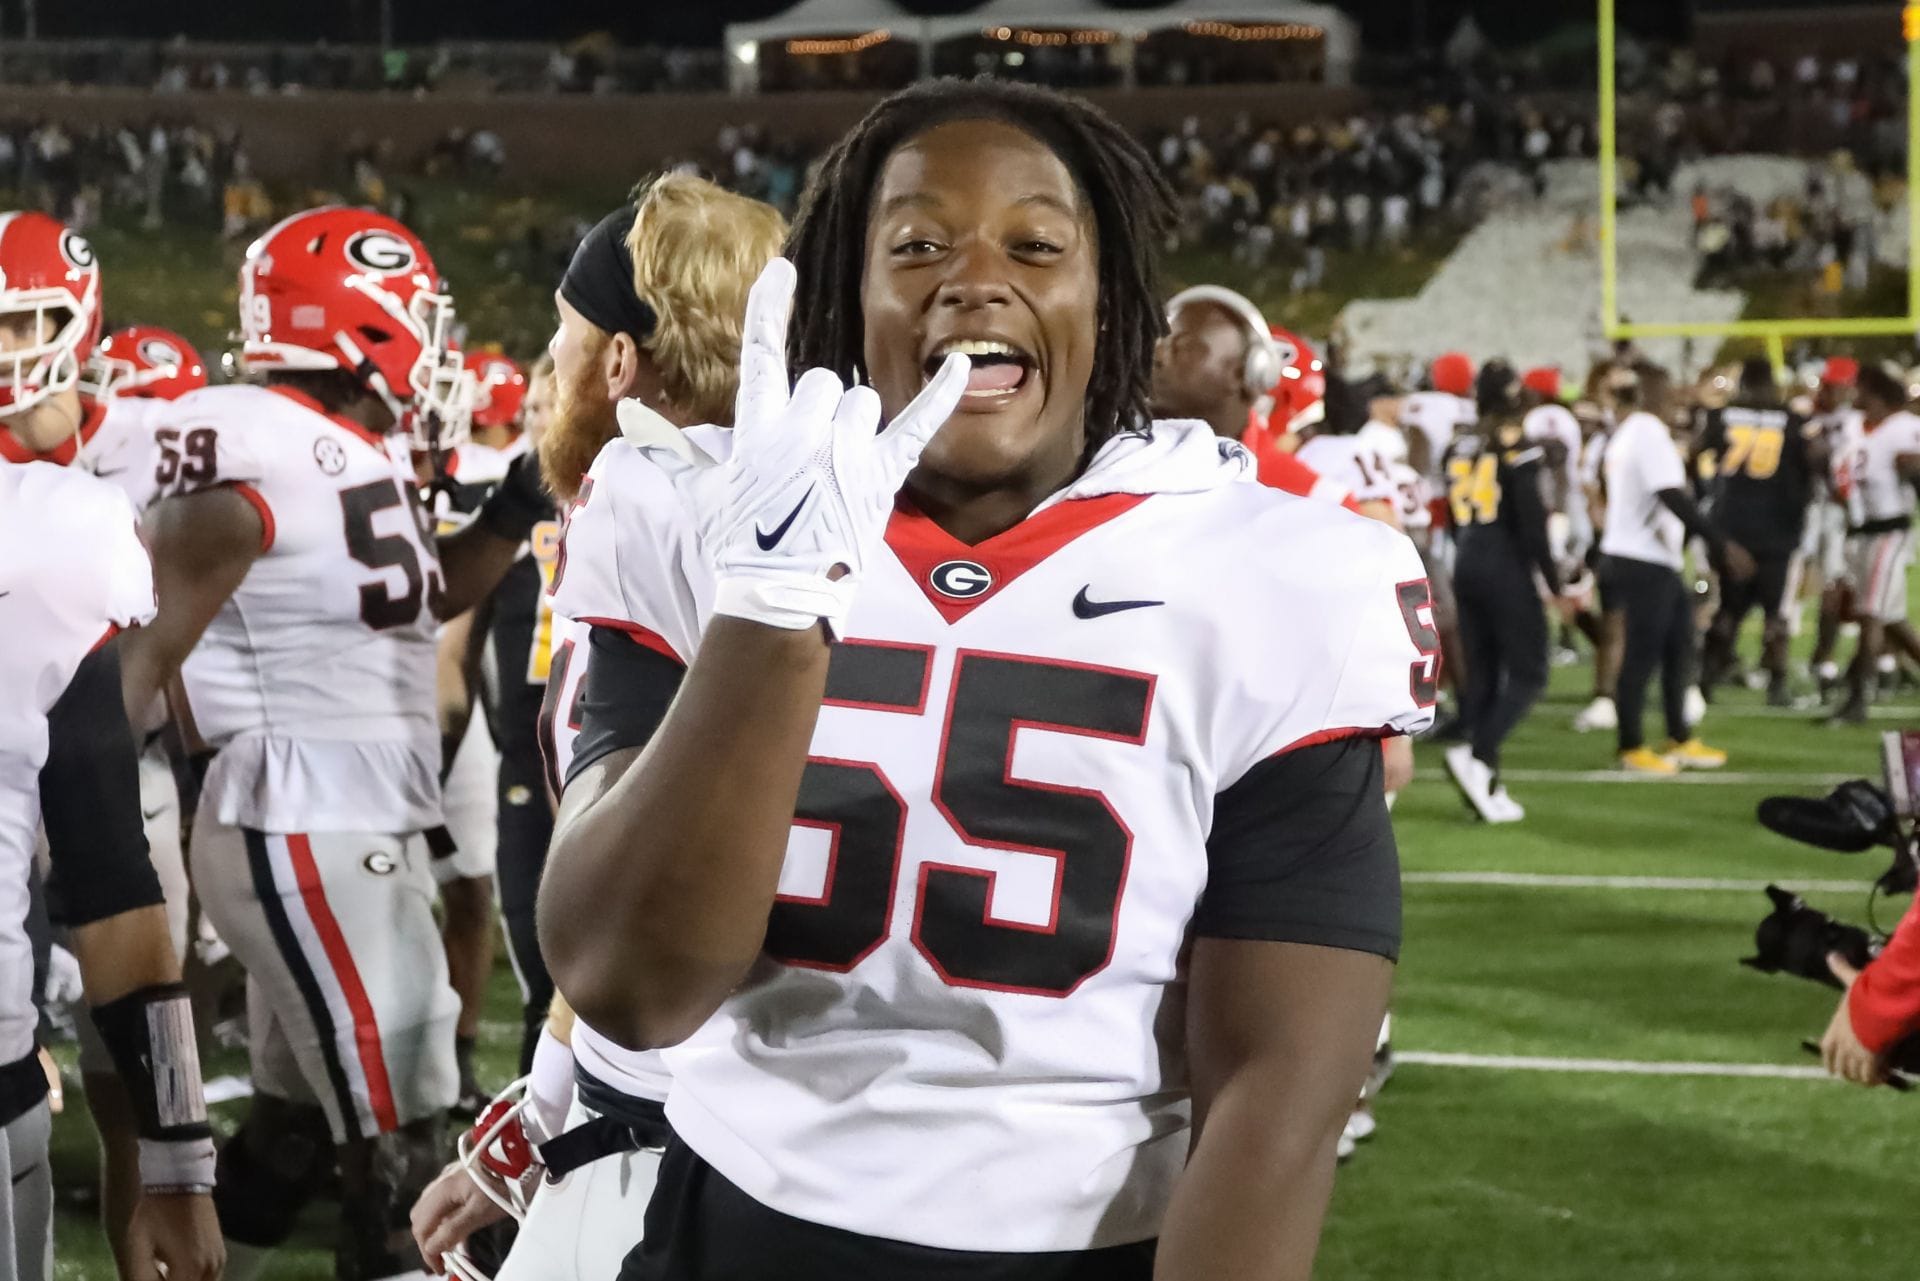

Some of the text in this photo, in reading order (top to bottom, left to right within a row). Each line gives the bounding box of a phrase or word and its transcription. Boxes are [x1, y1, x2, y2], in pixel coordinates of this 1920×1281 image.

[344, 229, 416, 277] G
[155, 428, 217, 485] 59
[930, 560, 991, 598] G
[763, 637, 1158, 999] 55
